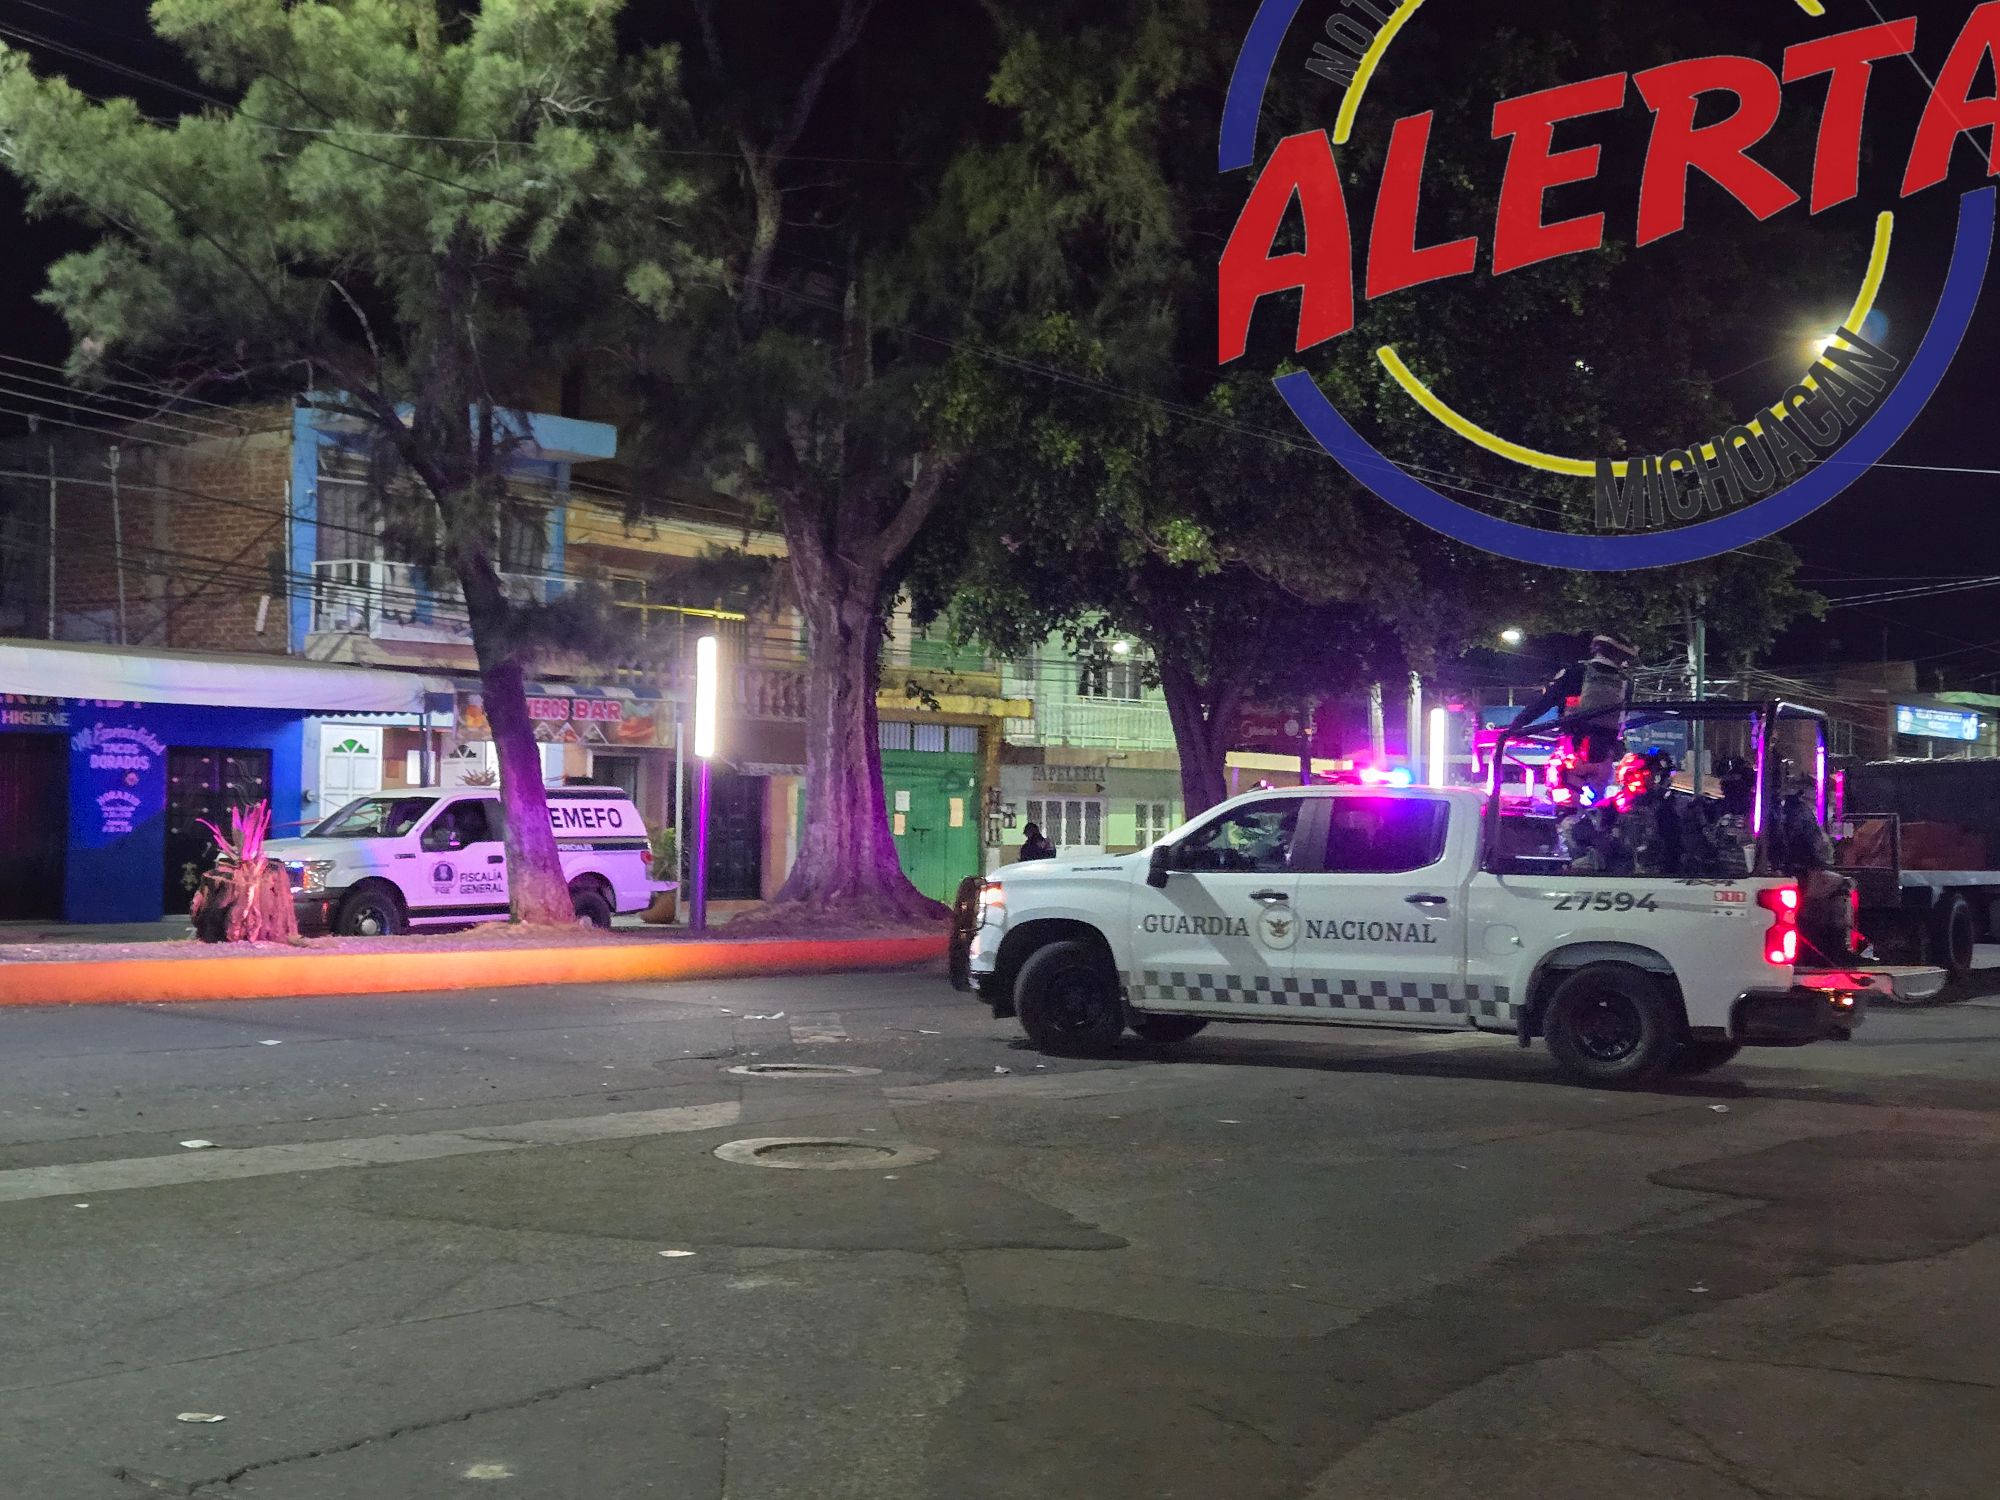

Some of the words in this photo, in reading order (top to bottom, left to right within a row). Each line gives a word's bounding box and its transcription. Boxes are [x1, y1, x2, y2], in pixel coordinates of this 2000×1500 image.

[1, 710, 71, 727] HIGIENE
[573, 699, 623, 722] BAR
[89, 754, 149, 771] DORADOS
[549, 807, 622, 829] EMEFO
[460, 883, 504, 895] GENERAL
[1554, 891, 1660, 913] 27594
[1142, 914, 1250, 937] GUARDIA
[1305, 919, 1437, 944] NACIONAL
